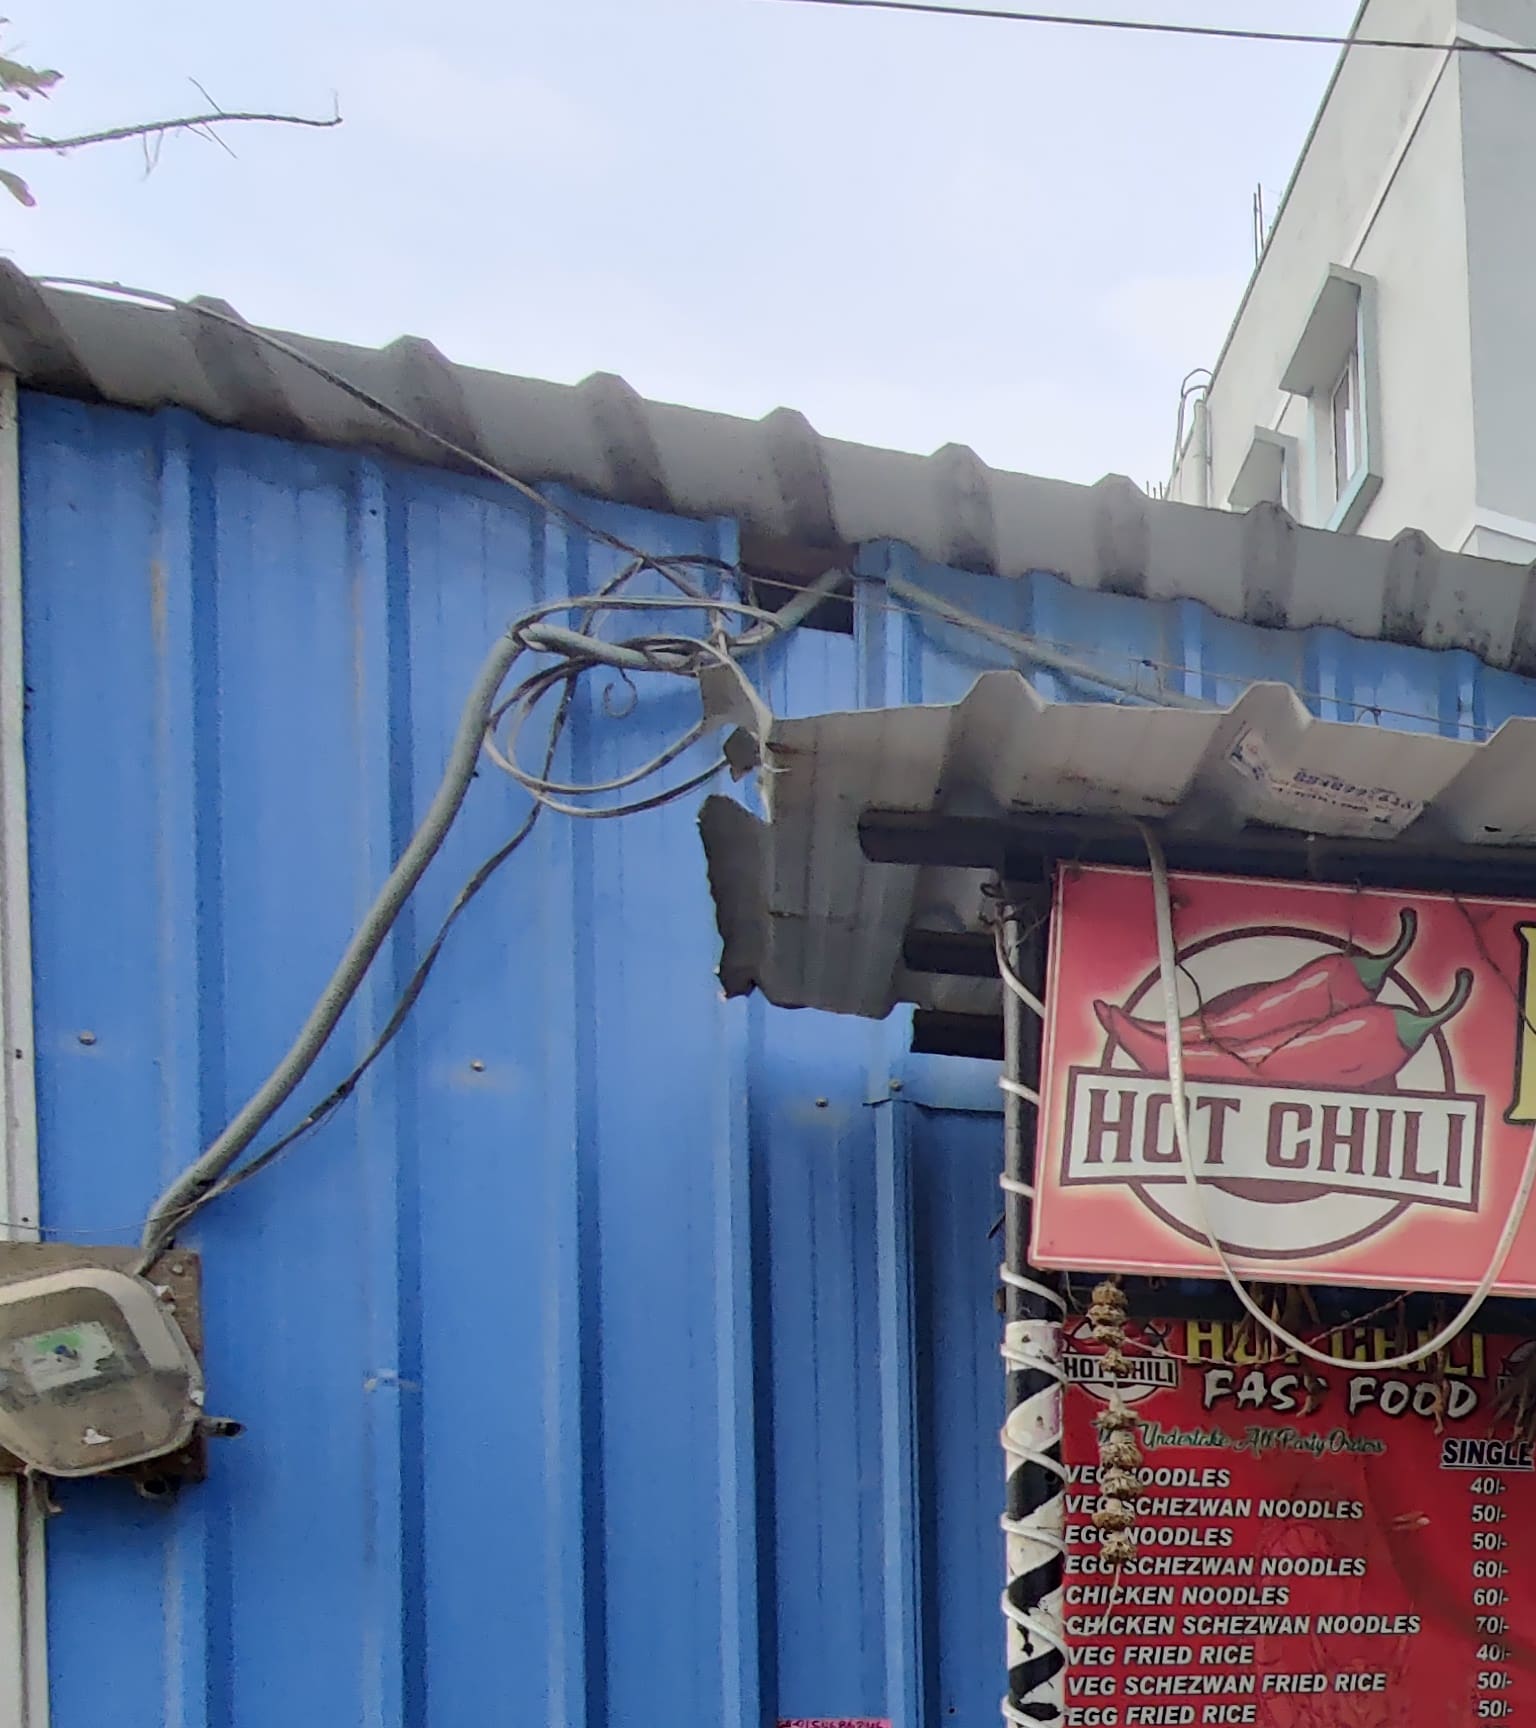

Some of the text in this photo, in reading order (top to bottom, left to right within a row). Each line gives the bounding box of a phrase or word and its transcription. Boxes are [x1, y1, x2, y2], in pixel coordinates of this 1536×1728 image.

[1083, 1088, 1467, 1189] HOT CHILI
[1187, 1320, 1300, 1365] HO
[1117, 1360, 1174, 1383] HILI
[1348, 1375, 1479, 1419] FOOD
[1442, 1438, 1535, 1465] SINGLE
[1133, 1468, 1230, 1487] OODLES
[1469, 1476, 1506, 1495] 40/-
[1259, 1500, 1364, 1519] NOODLES
[1471, 1504, 1507, 1523] 50/-
[1124, 1528, 1233, 1546] NOODLES
[1065, 1555, 1114, 1574] EGG
[1123, 1557, 1254, 1575] SCHEZWAN
[1261, 1557, 1367, 1577] NOODLES
[1472, 1560, 1509, 1579] 60/-
[1065, 1585, 1290, 1606] CHICKEN NOODLES
[1066, 1616, 1175, 1635] CHICKEN
[1182, 1615, 1310, 1635] SCHEZWAN
[1316, 1615, 1421, 1634] NOODLES
[1475, 1616, 1510, 1634] 70/-
[1068, 1647, 1115, 1665] VEG
[1123, 1646, 1193, 1665] FRIED
[1199, 1645, 1254, 1665] RICE
[1476, 1644, 1510, 1661] 40/-
[1068, 1676, 1116, 1696] VEG
[1124, 1674, 1256, 1696] SCHEZWAN
[1261, 1674, 1328, 1693] FRIED
[1334, 1673, 1387, 1692] RICE
[1477, 1671, 1513, 1690] 50/-
[1068, 1704, 1257, 1726] EGG FRIED RICE
